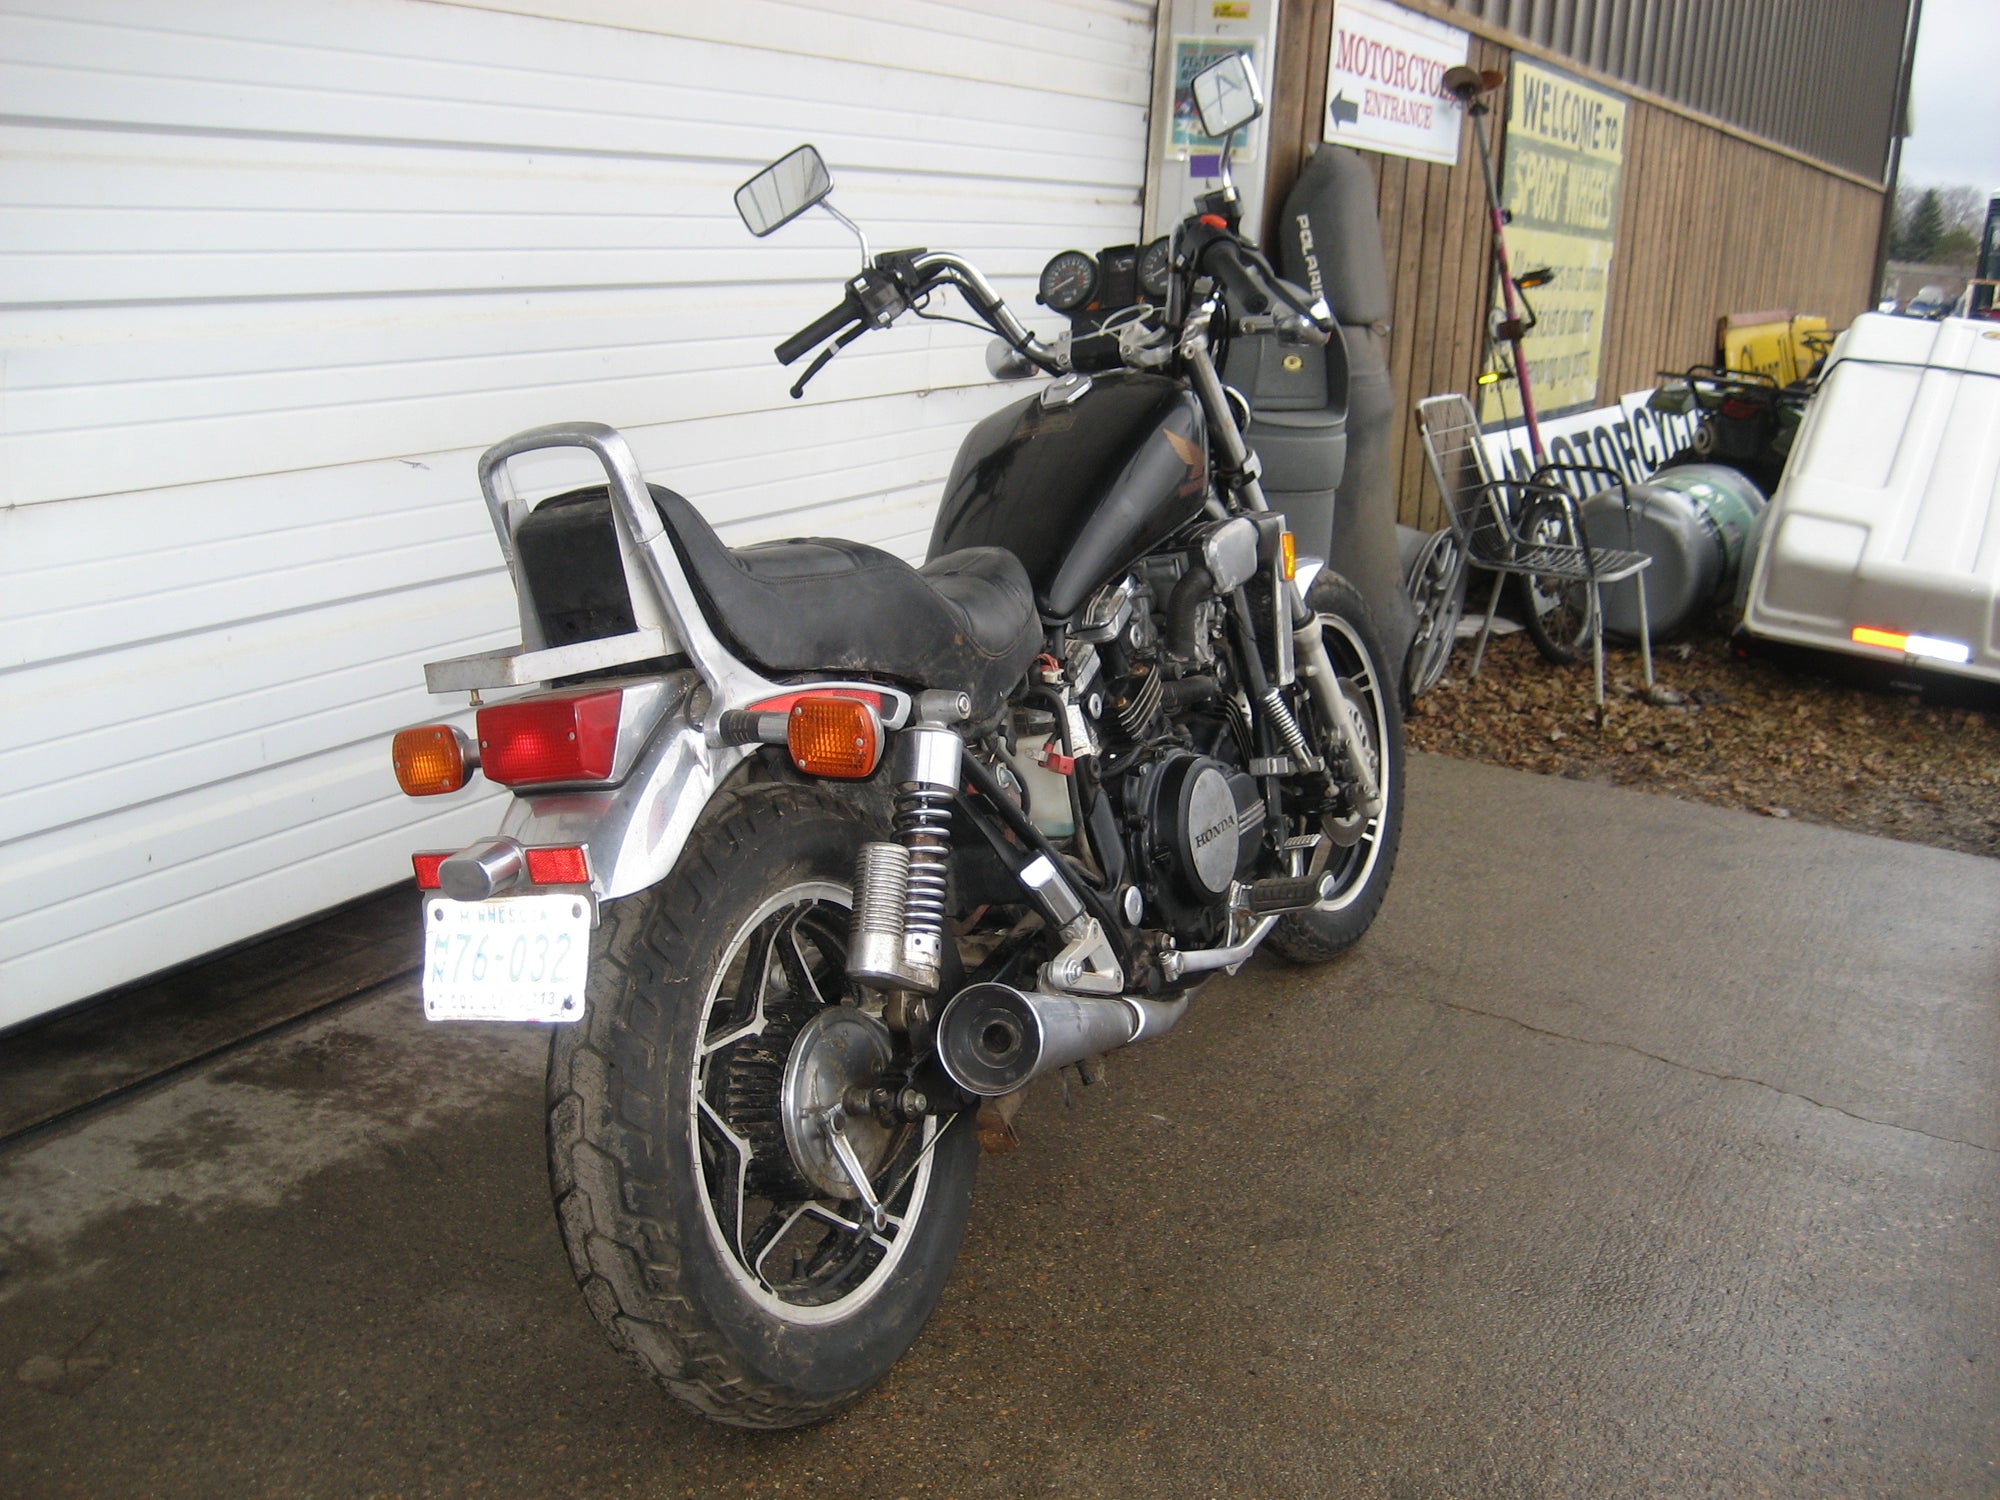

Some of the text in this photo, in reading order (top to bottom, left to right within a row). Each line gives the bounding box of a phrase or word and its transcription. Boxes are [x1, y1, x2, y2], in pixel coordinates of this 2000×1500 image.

[1335, 29, 1457, 103] MOTORCYCL
[1363, 89, 1432, 130] ENTRANCE
[1523, 74, 1603, 149] WELCOME
[1511, 150, 1570, 224] SPORT
[1195, 815, 1236, 848] HONDA
[453, 933, 572, 983] 76-032
